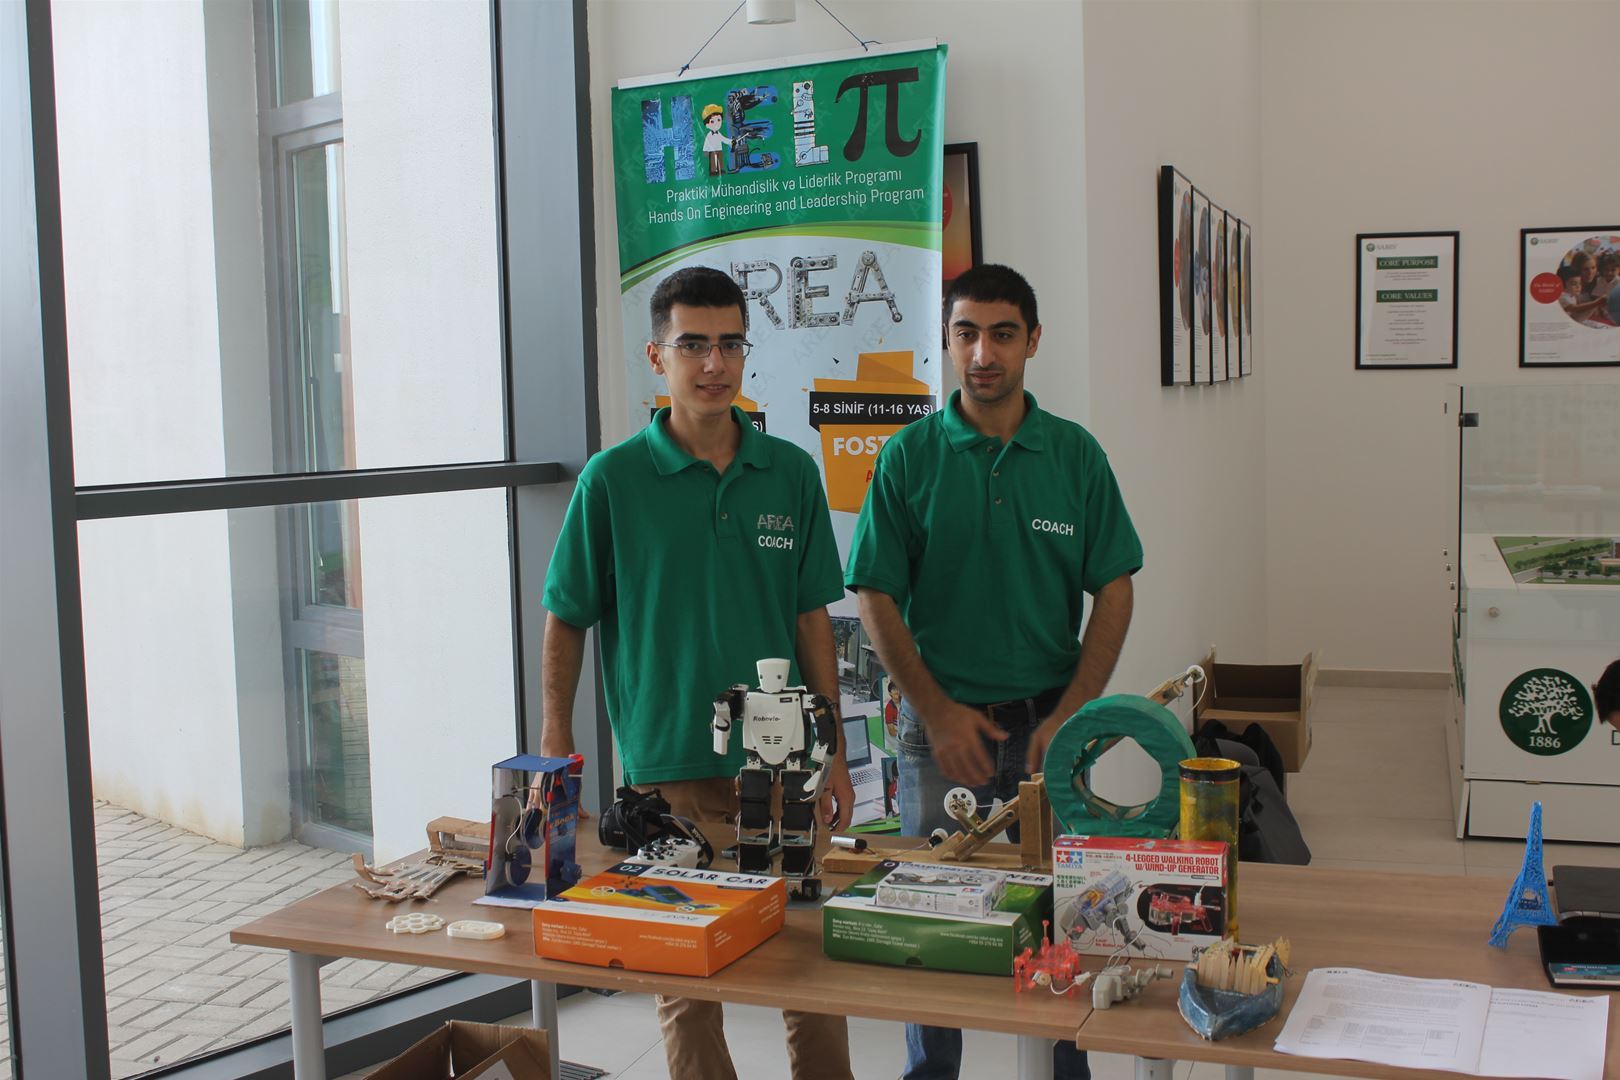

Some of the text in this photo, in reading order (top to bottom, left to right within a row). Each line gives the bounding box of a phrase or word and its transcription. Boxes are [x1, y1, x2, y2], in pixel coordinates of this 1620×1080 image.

[666, 186, 708, 203] Praktiki
[711, 179, 780, 199] Mühəndislik
[799, 171, 842, 189] Liderlik
[845, 170, 902, 186] Programı
[648, 188, 924, 224] Hands On Engineering and Leadership Program
[1379, 258, 1436, 267] CORE PURPOSE
[730, 250, 903, 330] REA
[1381, 292, 1402, 300] CORE
[812, 403, 830, 414] 5-8
[833, 401, 865, 414] SİNİF
[868, 404, 904, 416] (11-16
[833, 435, 891, 456] FOST
[1031, 518, 1074, 536] COACH
[758, 535, 794, 550] COACH
[1528, 736, 1562, 749] 1886
[1161, 855, 1194, 865] WALKING
[1195, 857, 1219, 866] ROBOT
[619, 865, 768, 885] 02 SOLAR CAR
[1178, 865, 1219, 875] GENERATOR
